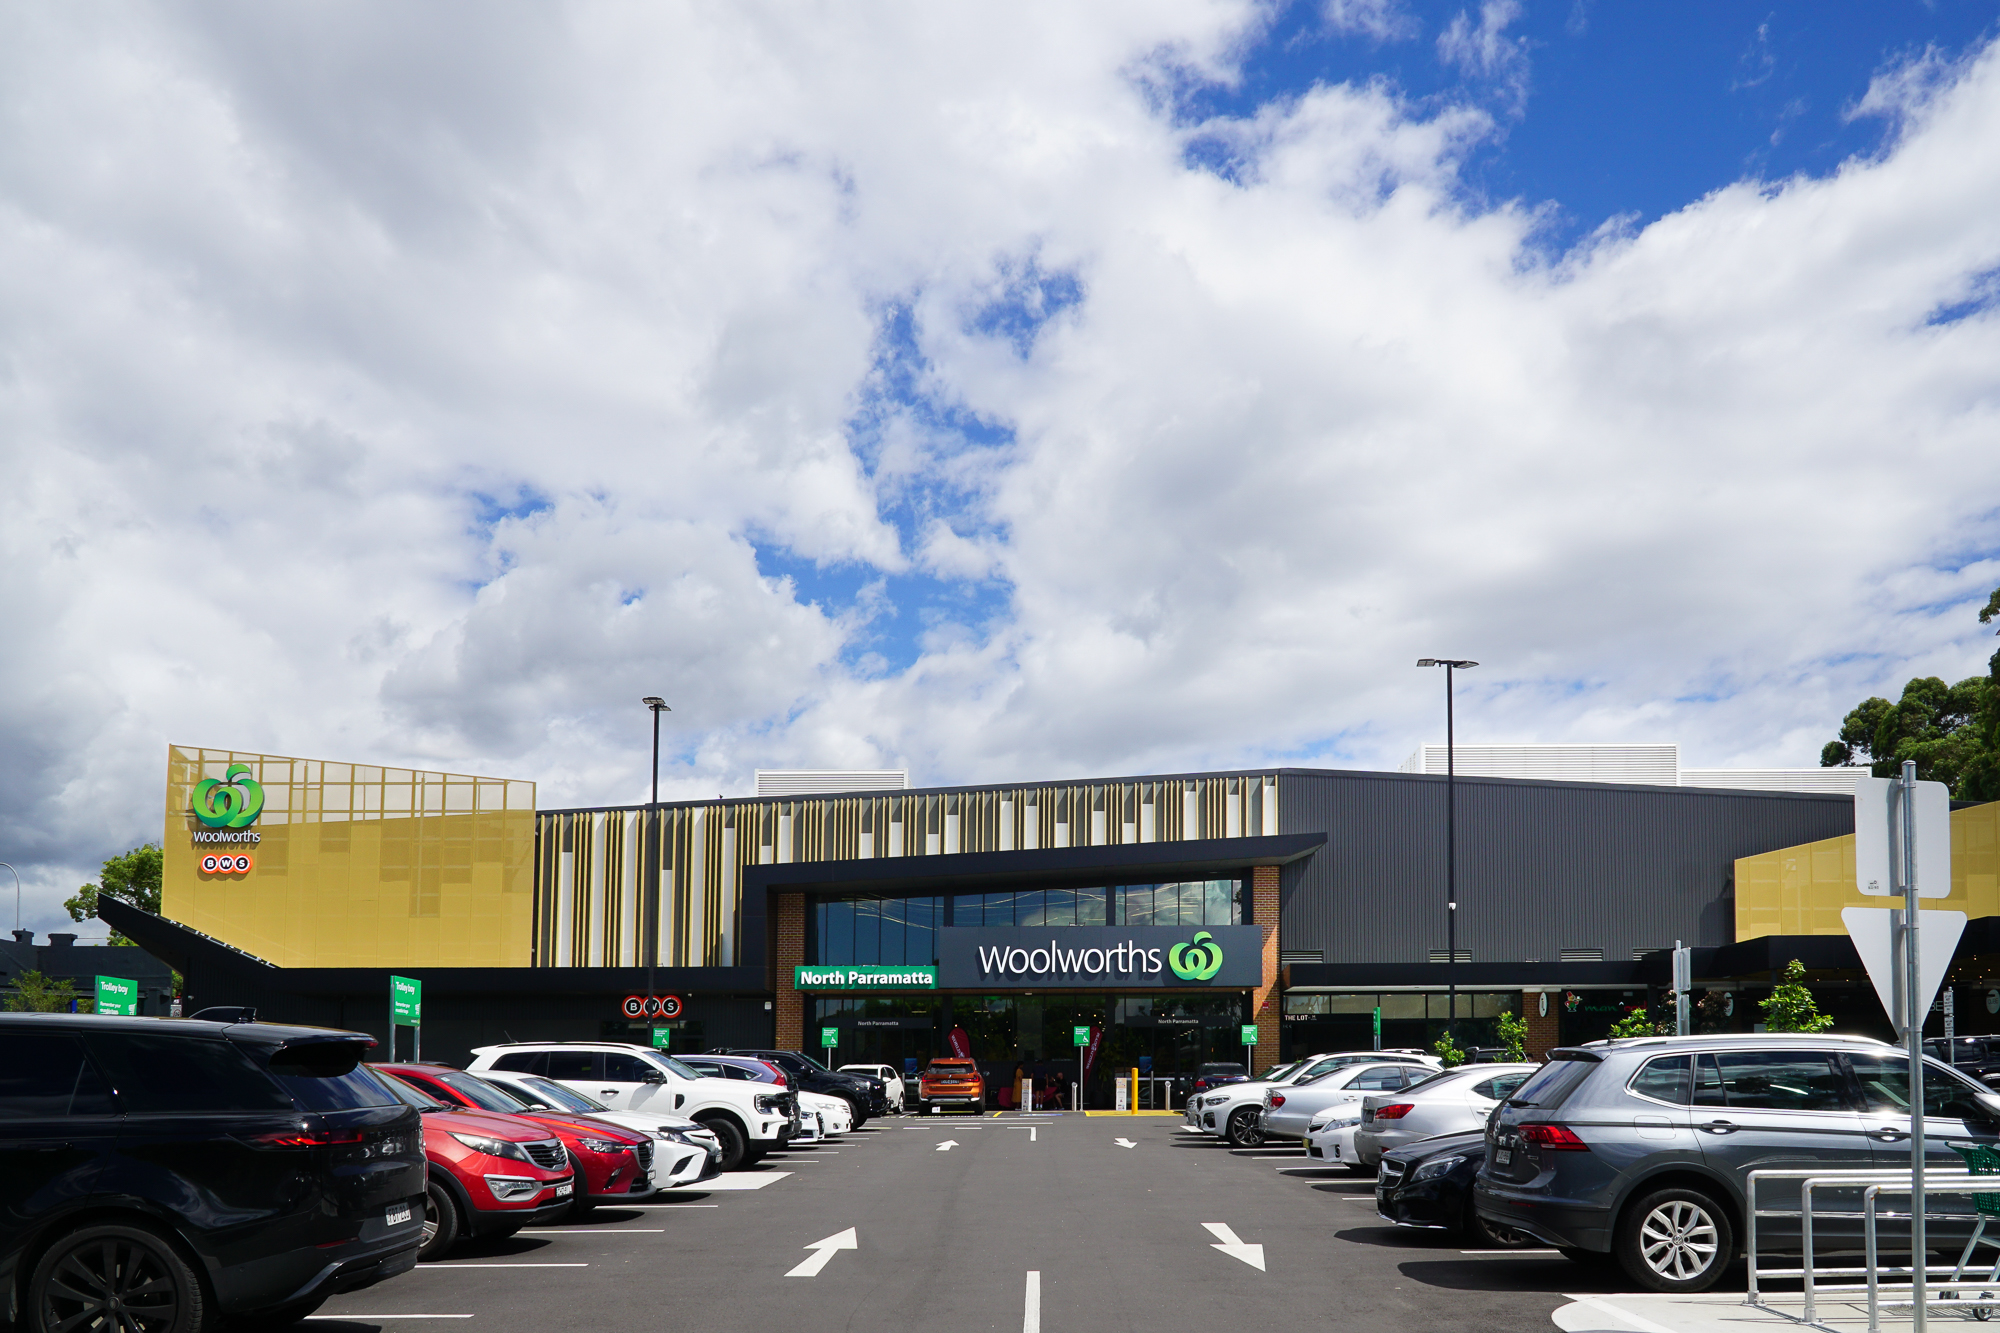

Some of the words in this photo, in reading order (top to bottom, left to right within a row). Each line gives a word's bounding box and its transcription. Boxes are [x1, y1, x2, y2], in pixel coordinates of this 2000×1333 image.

[193, 829, 261, 843] Woolworths
[978, 939, 1163, 974] Woolworths
[800, 970, 845, 985] North
[848, 971, 933, 985] Parramatta
[100, 981, 118, 994] Trolley
[118, 984, 128, 995] bay
